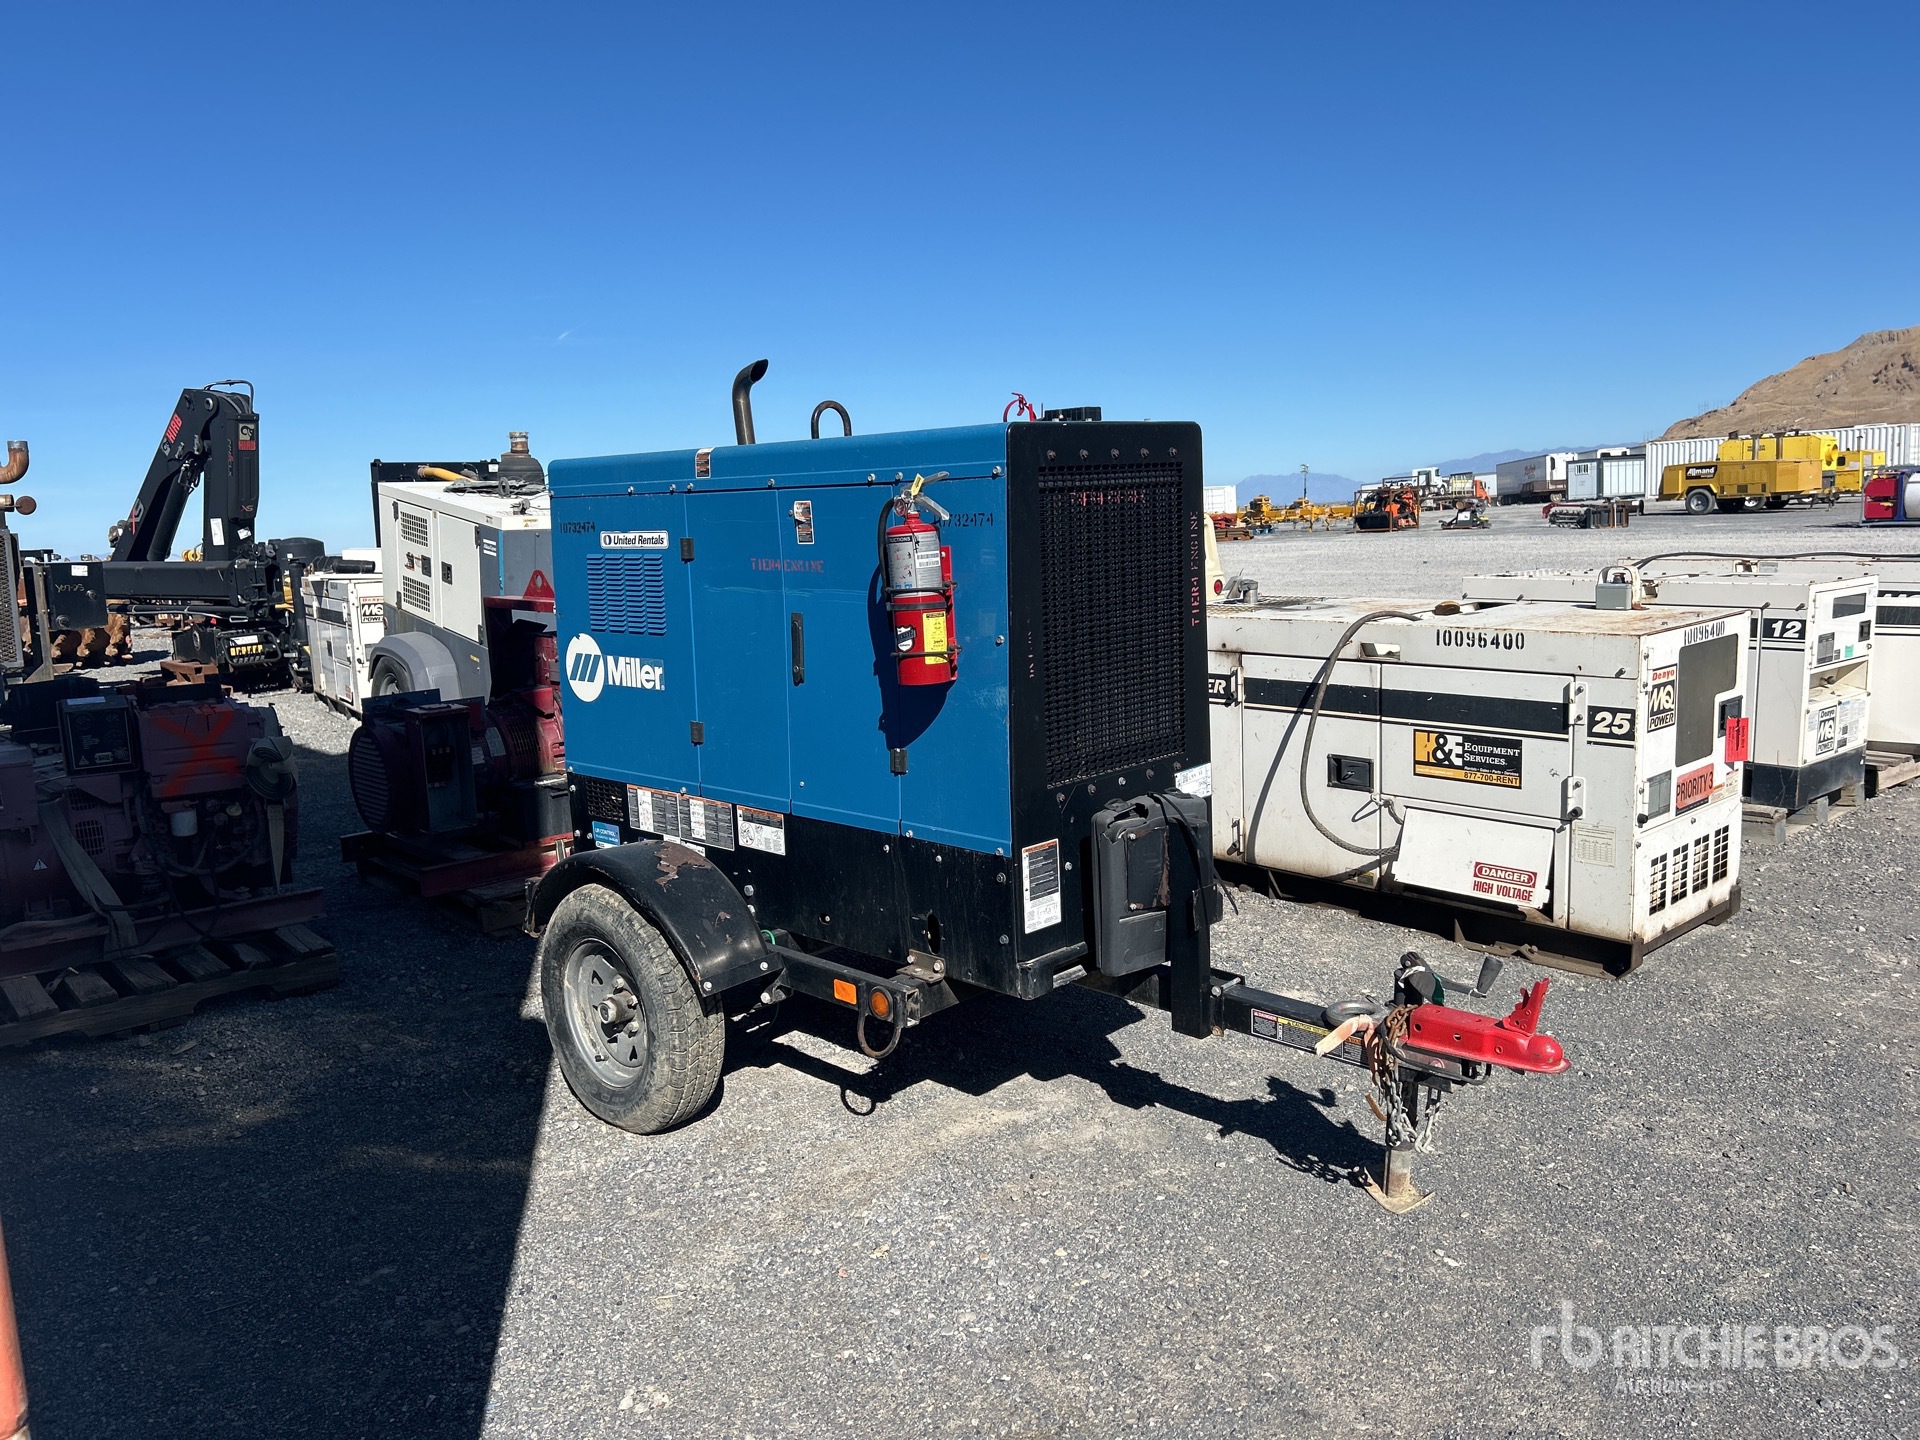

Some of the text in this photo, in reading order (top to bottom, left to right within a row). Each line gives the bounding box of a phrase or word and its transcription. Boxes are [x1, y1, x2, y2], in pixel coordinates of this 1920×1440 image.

[560, 521, 595, 533] 10732474
[613, 535, 665, 546] United Rentals
[1683, 620, 1726, 646] 10096400
[1771, 620, 1802, 638] 12
[1436, 629, 1525, 650] 10096400
[606, 655, 662, 690] Miller
[1652, 669, 1675, 681] Denyo
[1650, 684, 1675, 712] MQ
[1592, 711, 1631, 735] 25
[1649, 712, 1674, 729] POWER
[1415, 731, 1463, 766] H&E
[1464, 742, 1520, 757] EQUIPMENT
[1464, 753, 1506, 766] SERVICES
[1463, 772, 1519, 785] 877-700-RENT
[1677, 772, 1708, 802] PRIORITY
[1708, 771, 1714, 790] 3
[1481, 867, 1529, 883] DANGER
[1472, 880, 1534, 902] HIGH VOLTAGE
